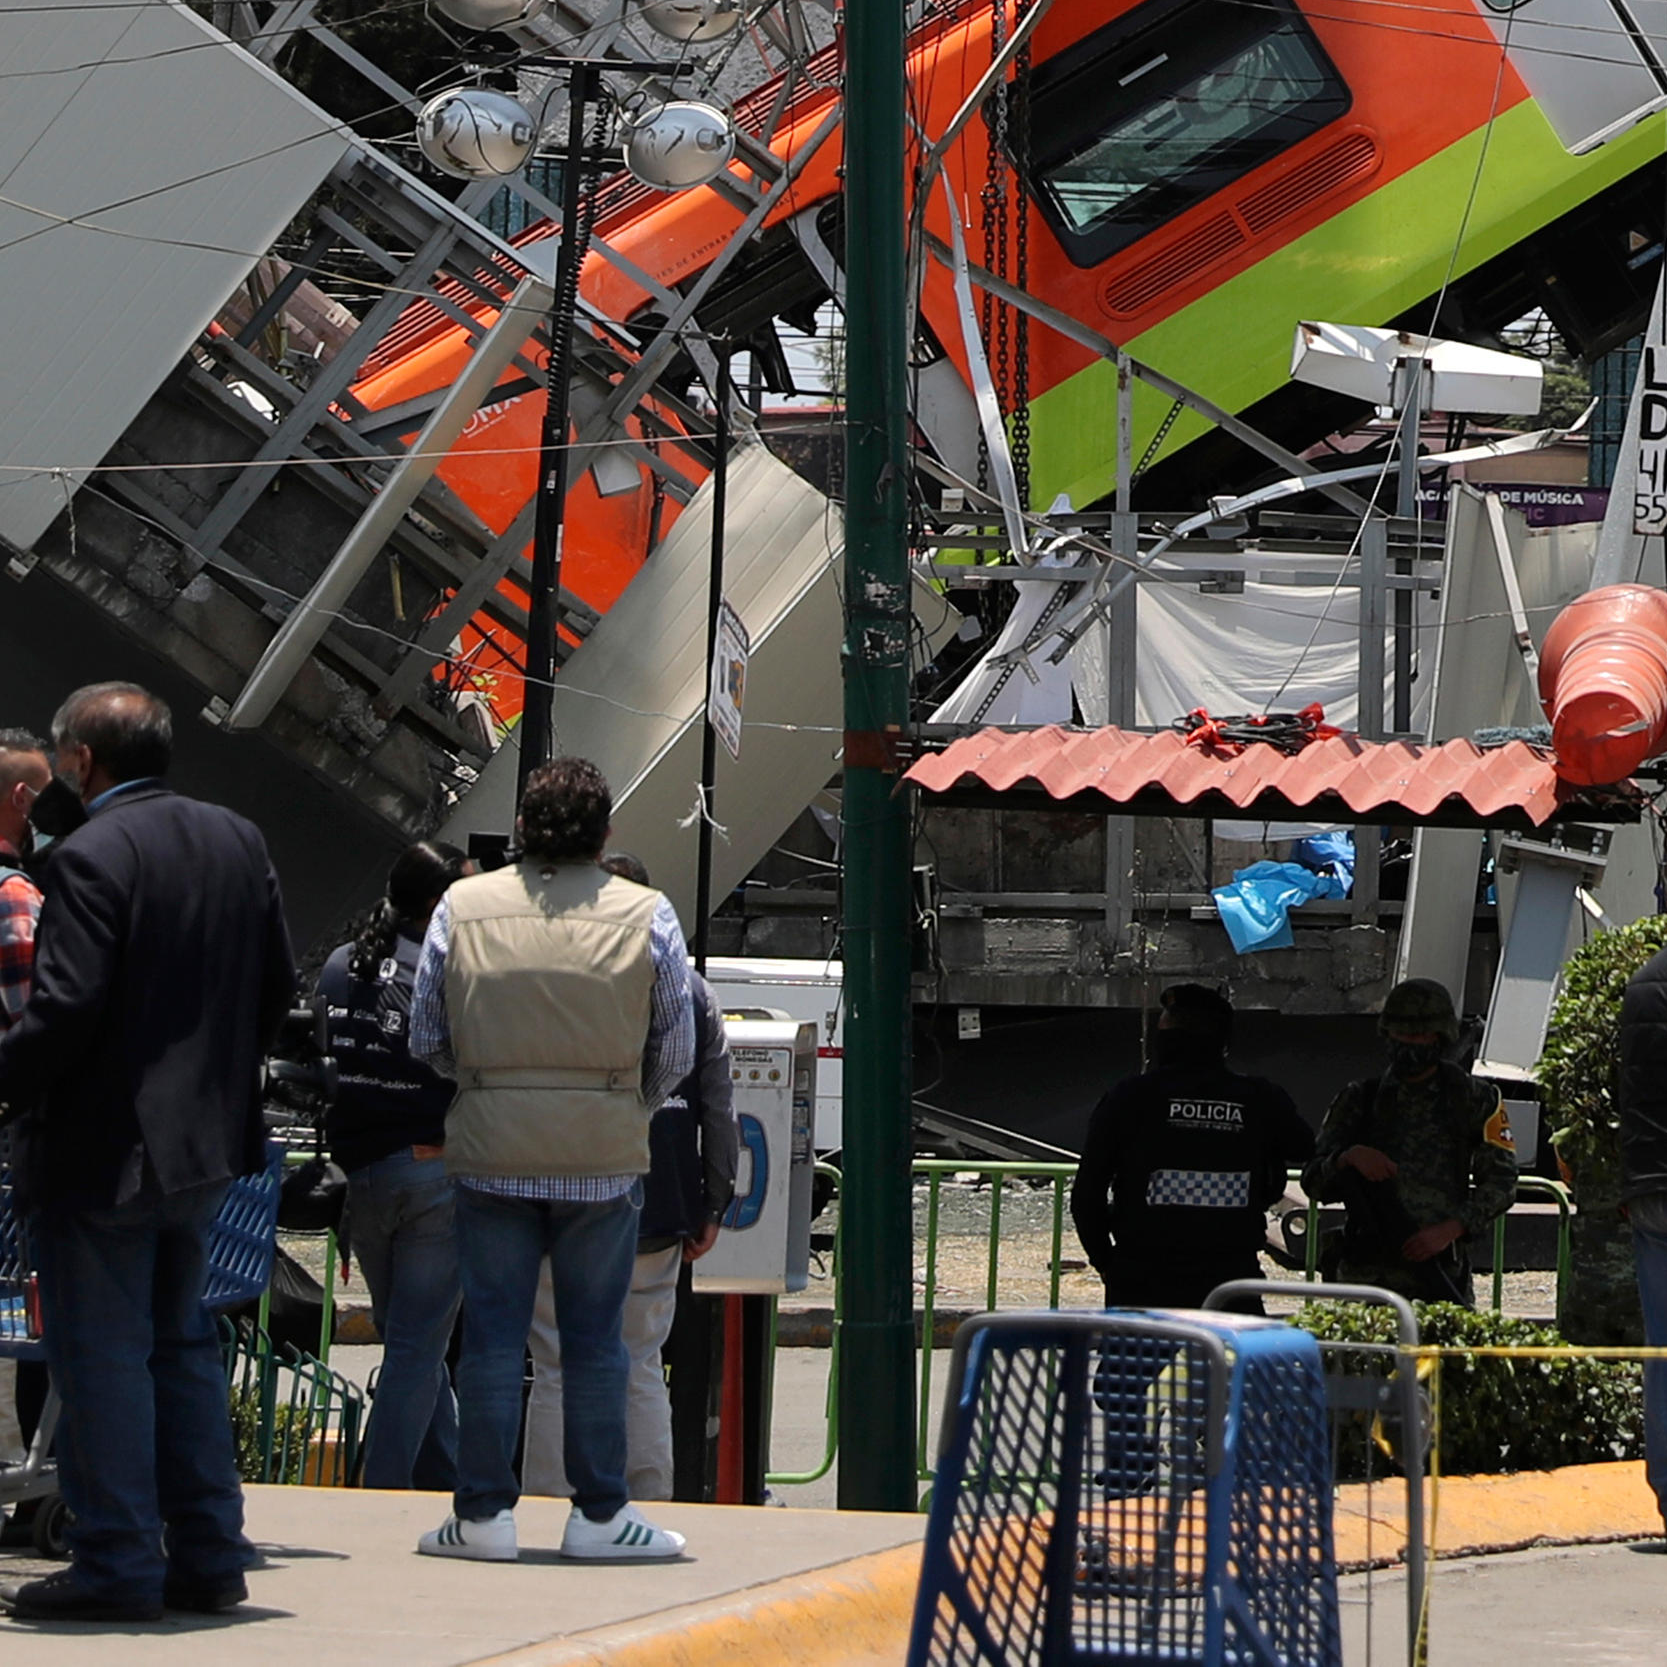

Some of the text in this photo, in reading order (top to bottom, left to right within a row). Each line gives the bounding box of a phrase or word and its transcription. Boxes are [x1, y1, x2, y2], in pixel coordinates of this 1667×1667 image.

[1501, 491, 1521, 503] DE
[1523, 489, 1584, 505] MÚSICA
[1170, 1103, 1243, 1123] POLICÍA
